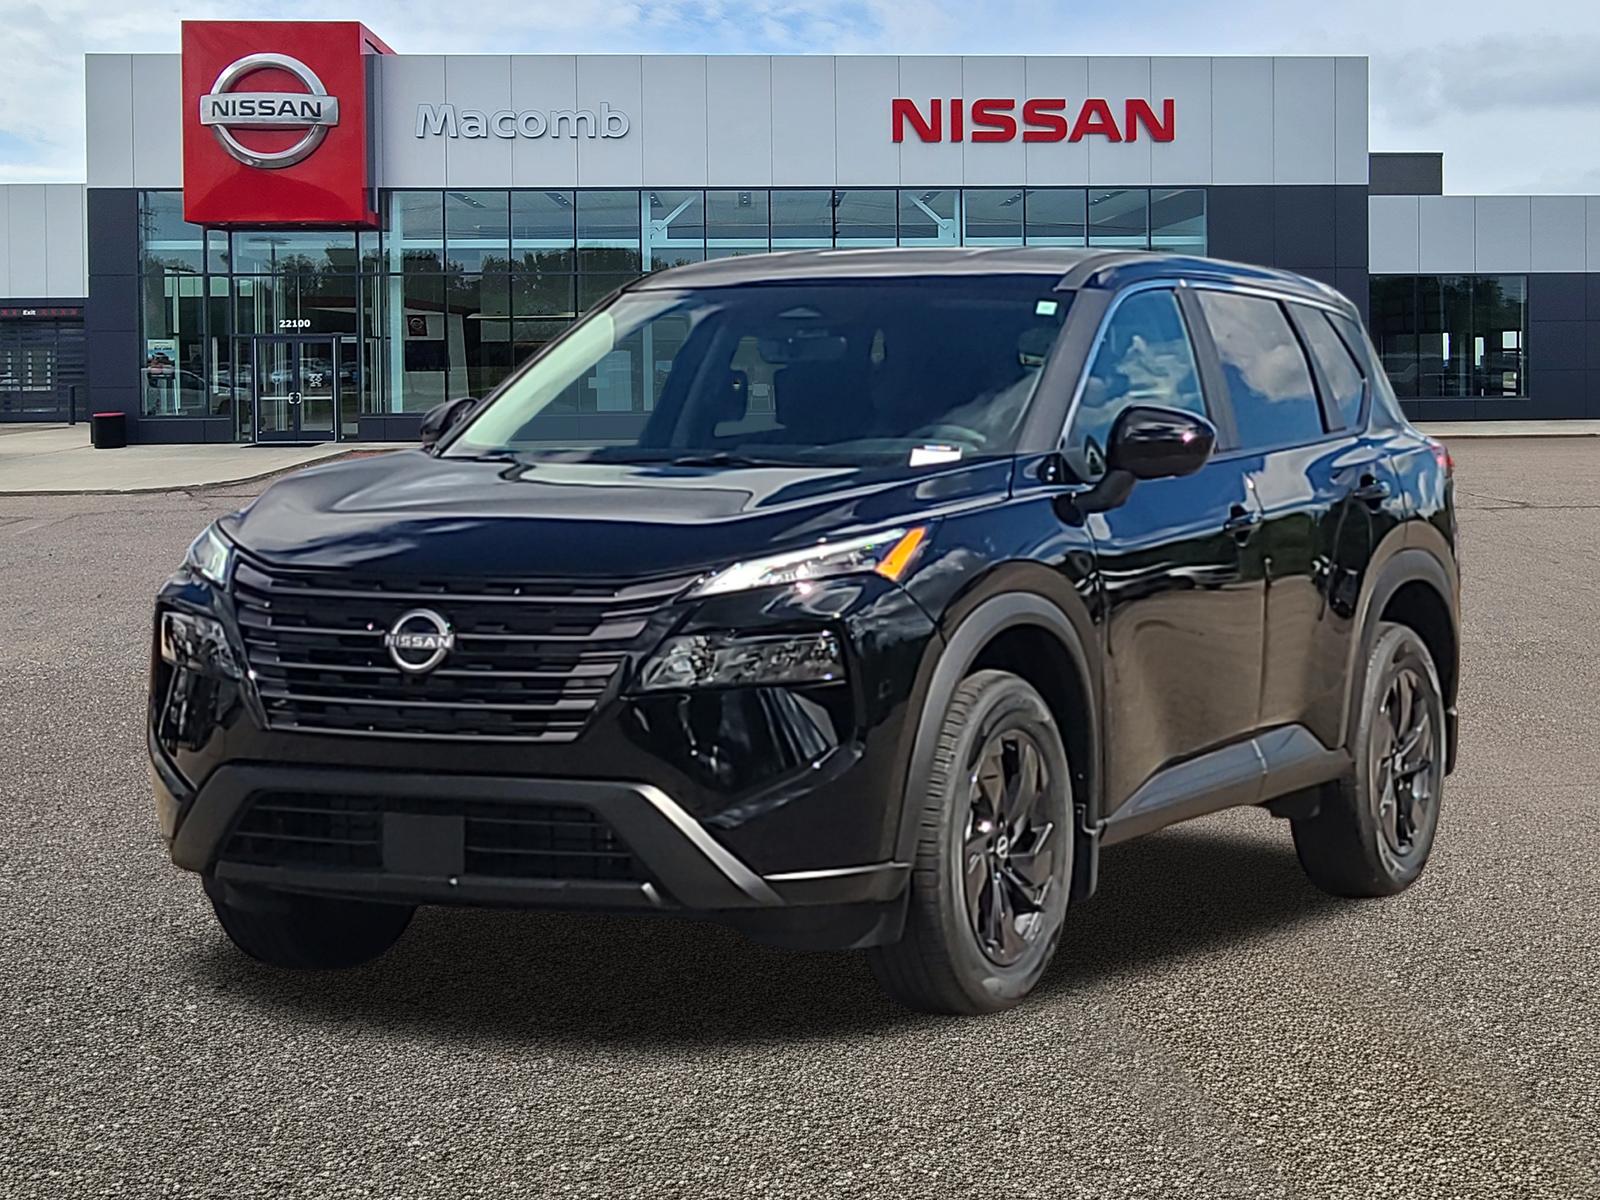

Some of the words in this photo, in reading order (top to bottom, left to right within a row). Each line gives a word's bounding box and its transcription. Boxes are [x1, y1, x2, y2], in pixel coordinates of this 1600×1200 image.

[211, 100, 322, 117] NISSAN
[415, 102, 630, 139] Macomb
[892, 98, 1175, 143] NISSAN
[279, 319, 311, 328] 22100
[385, 633, 454, 649] NISSAN
